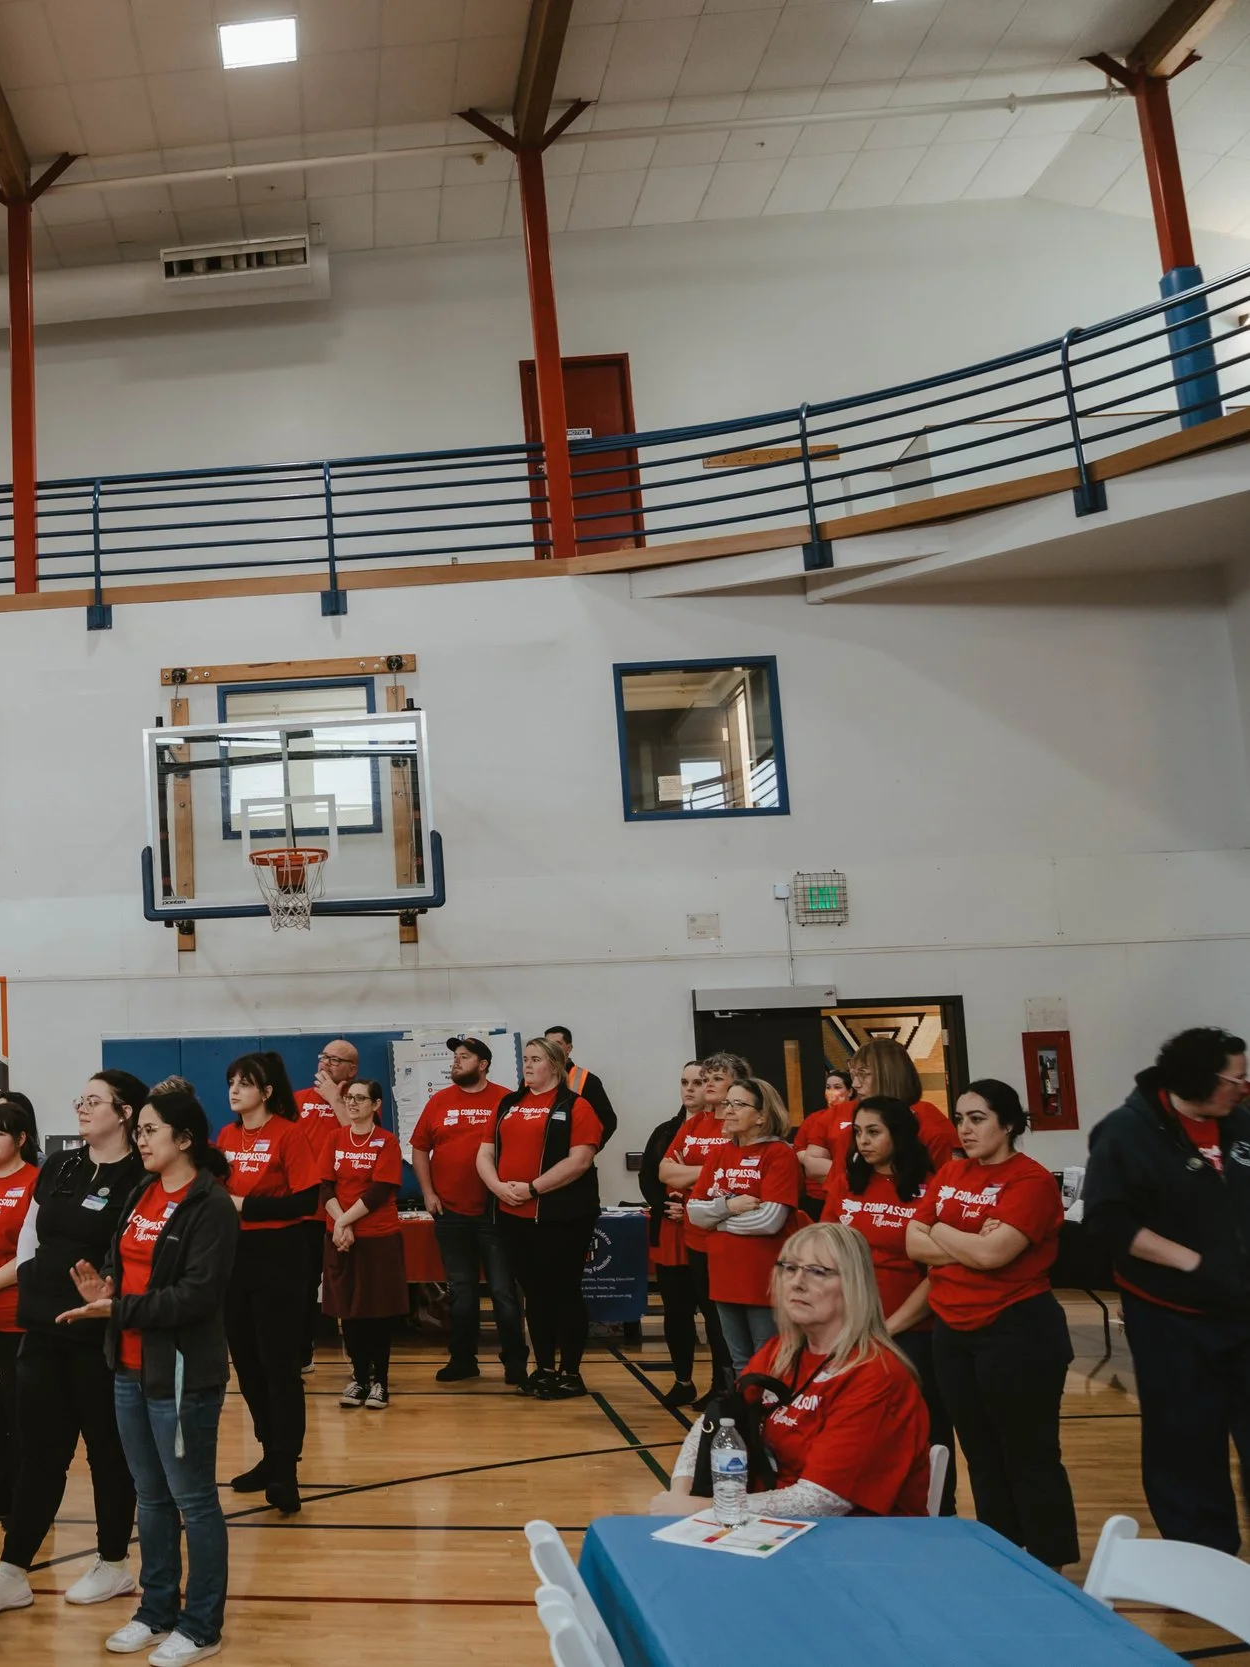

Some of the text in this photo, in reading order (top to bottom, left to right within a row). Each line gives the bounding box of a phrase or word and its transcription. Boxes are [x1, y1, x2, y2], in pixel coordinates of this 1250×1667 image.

[808, 886, 839, 910] EXIT
[863, 1202, 917, 1219] COMPASSIO
[593, 1226, 612, 1246] hildren
